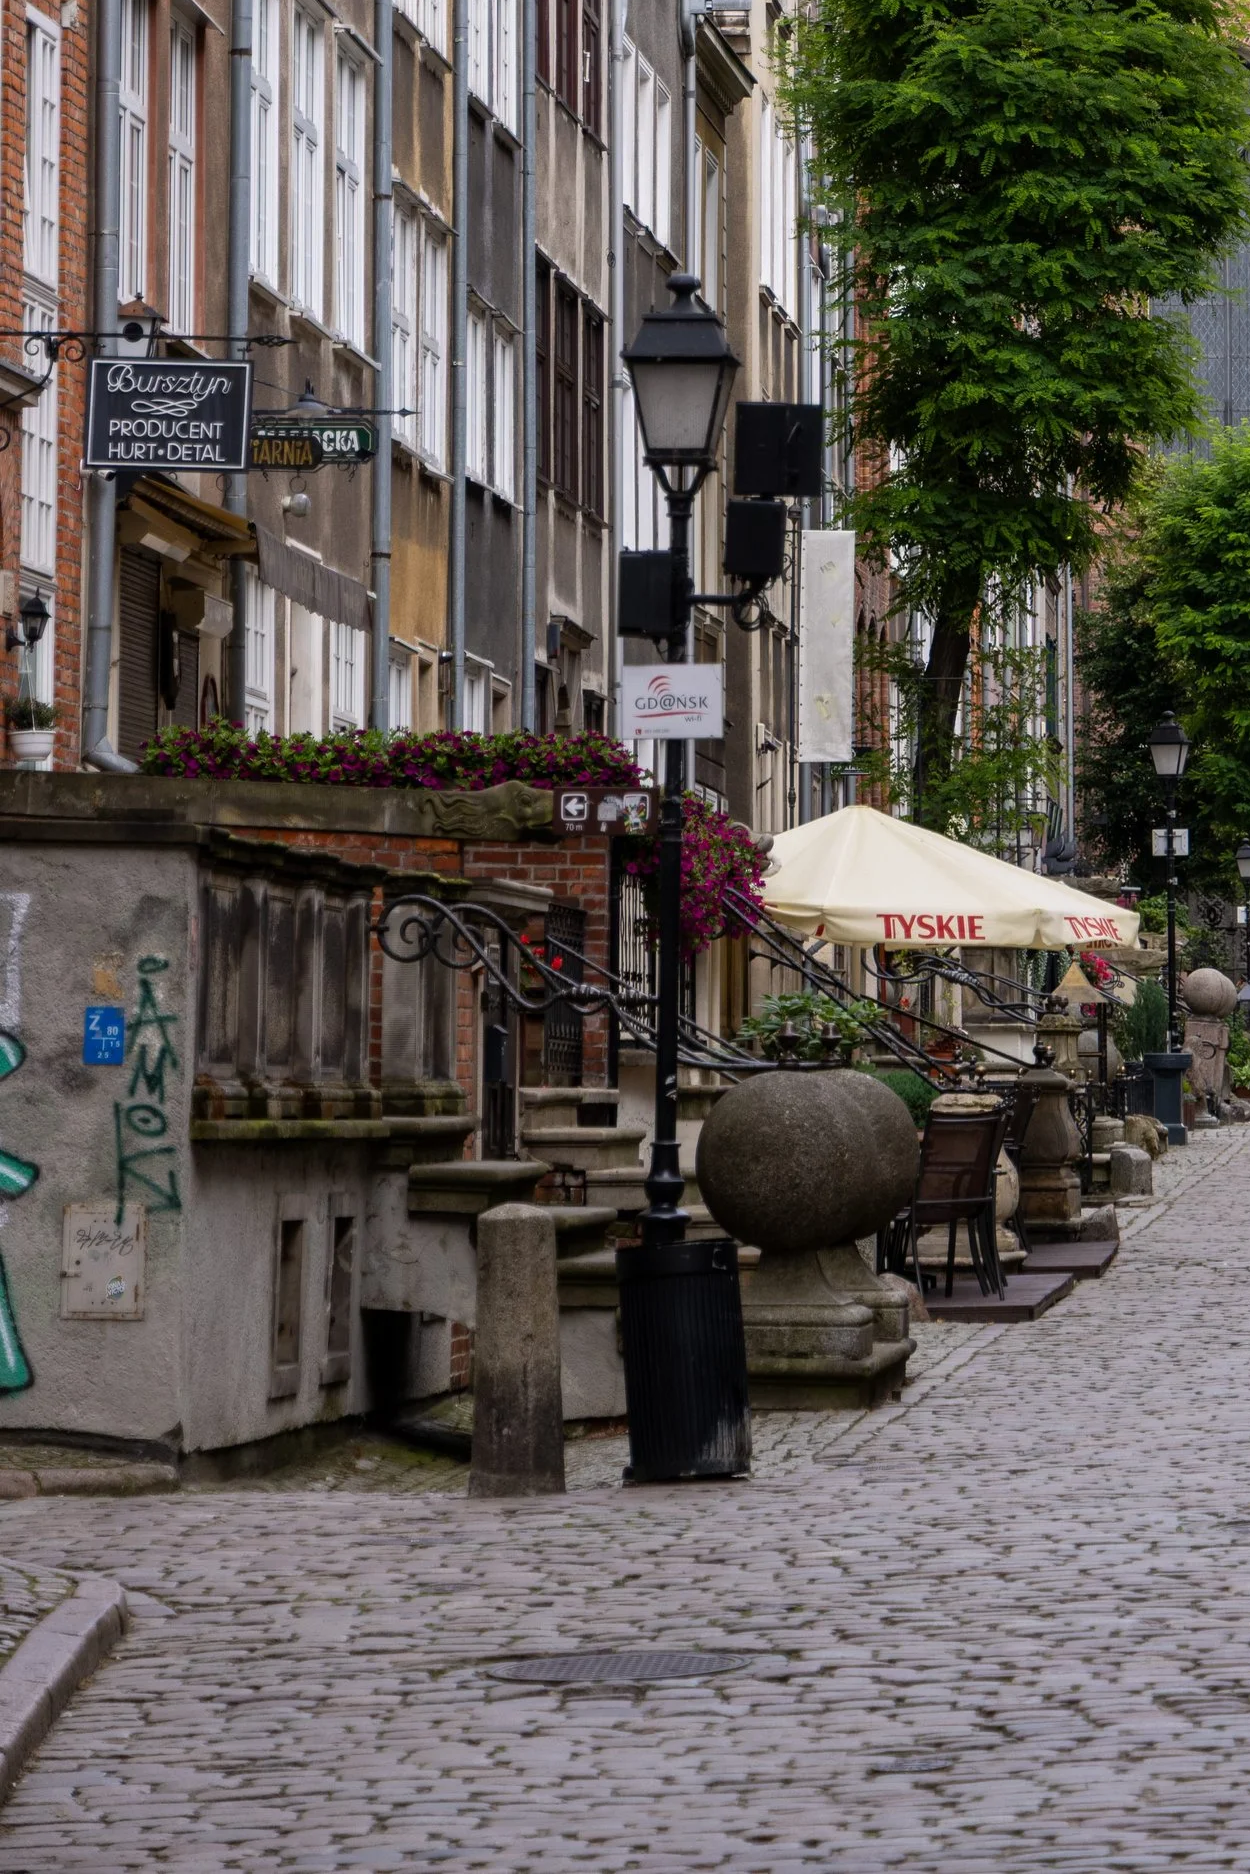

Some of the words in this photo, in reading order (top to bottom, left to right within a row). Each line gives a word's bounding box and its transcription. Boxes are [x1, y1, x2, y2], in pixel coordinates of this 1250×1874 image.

[107, 364, 232, 401] Bursztyn
[109, 419, 224, 439] PRODUCENT
[876, 913, 986, 940] TYSKIE
[1063, 916, 1123, 942] TYSKIE
[89, 1015, 101, 1031] Z
[106, 1026, 119, 1036] 80
